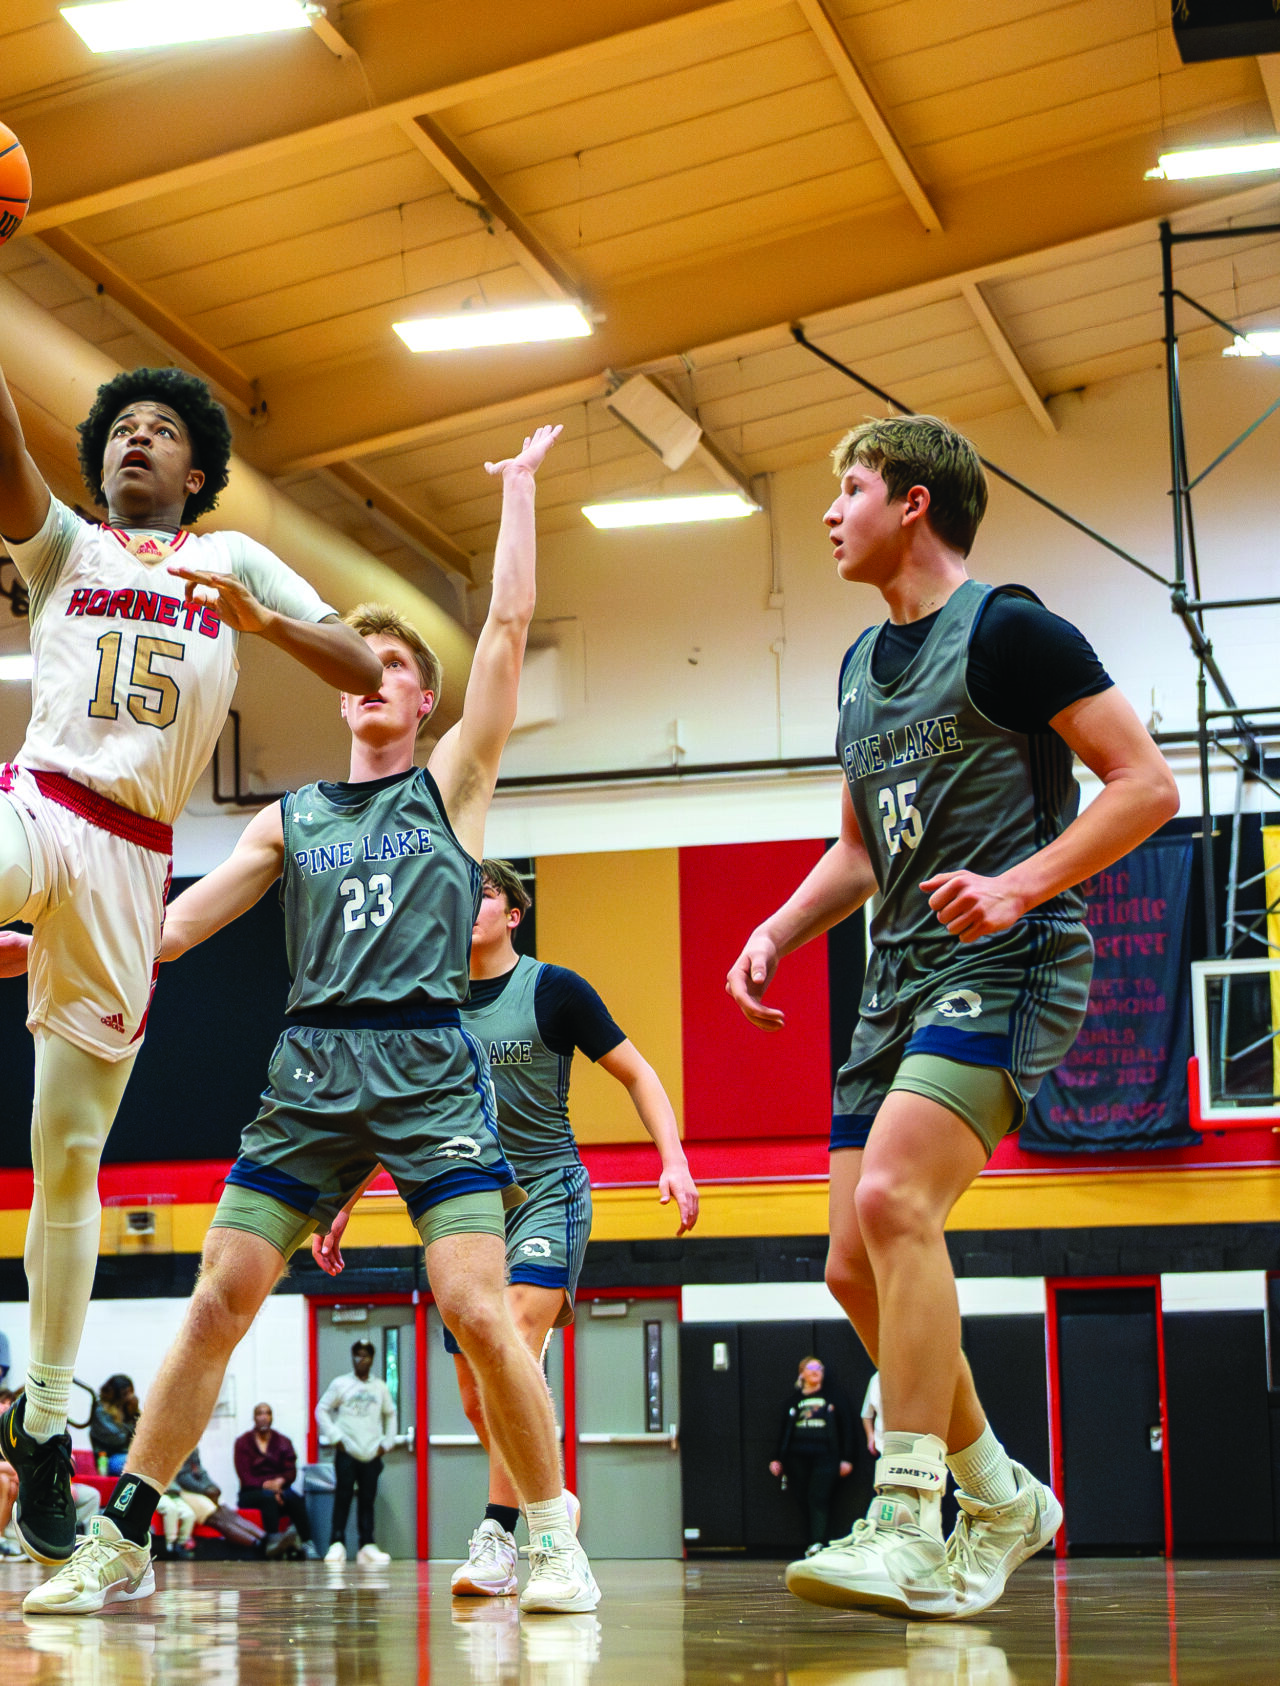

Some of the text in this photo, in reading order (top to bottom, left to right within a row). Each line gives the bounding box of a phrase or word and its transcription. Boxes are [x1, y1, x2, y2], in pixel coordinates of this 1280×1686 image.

[65, 588, 220, 639] HORNETS
[88, 631, 185, 730] 15
[844, 714, 963, 783] PINE LAKE
[878, 779, 924, 857] 25
[294, 827, 434, 881] PINE LAKE
[338, 872, 395, 934] 23
[489, 1040, 532, 1066] AKE
